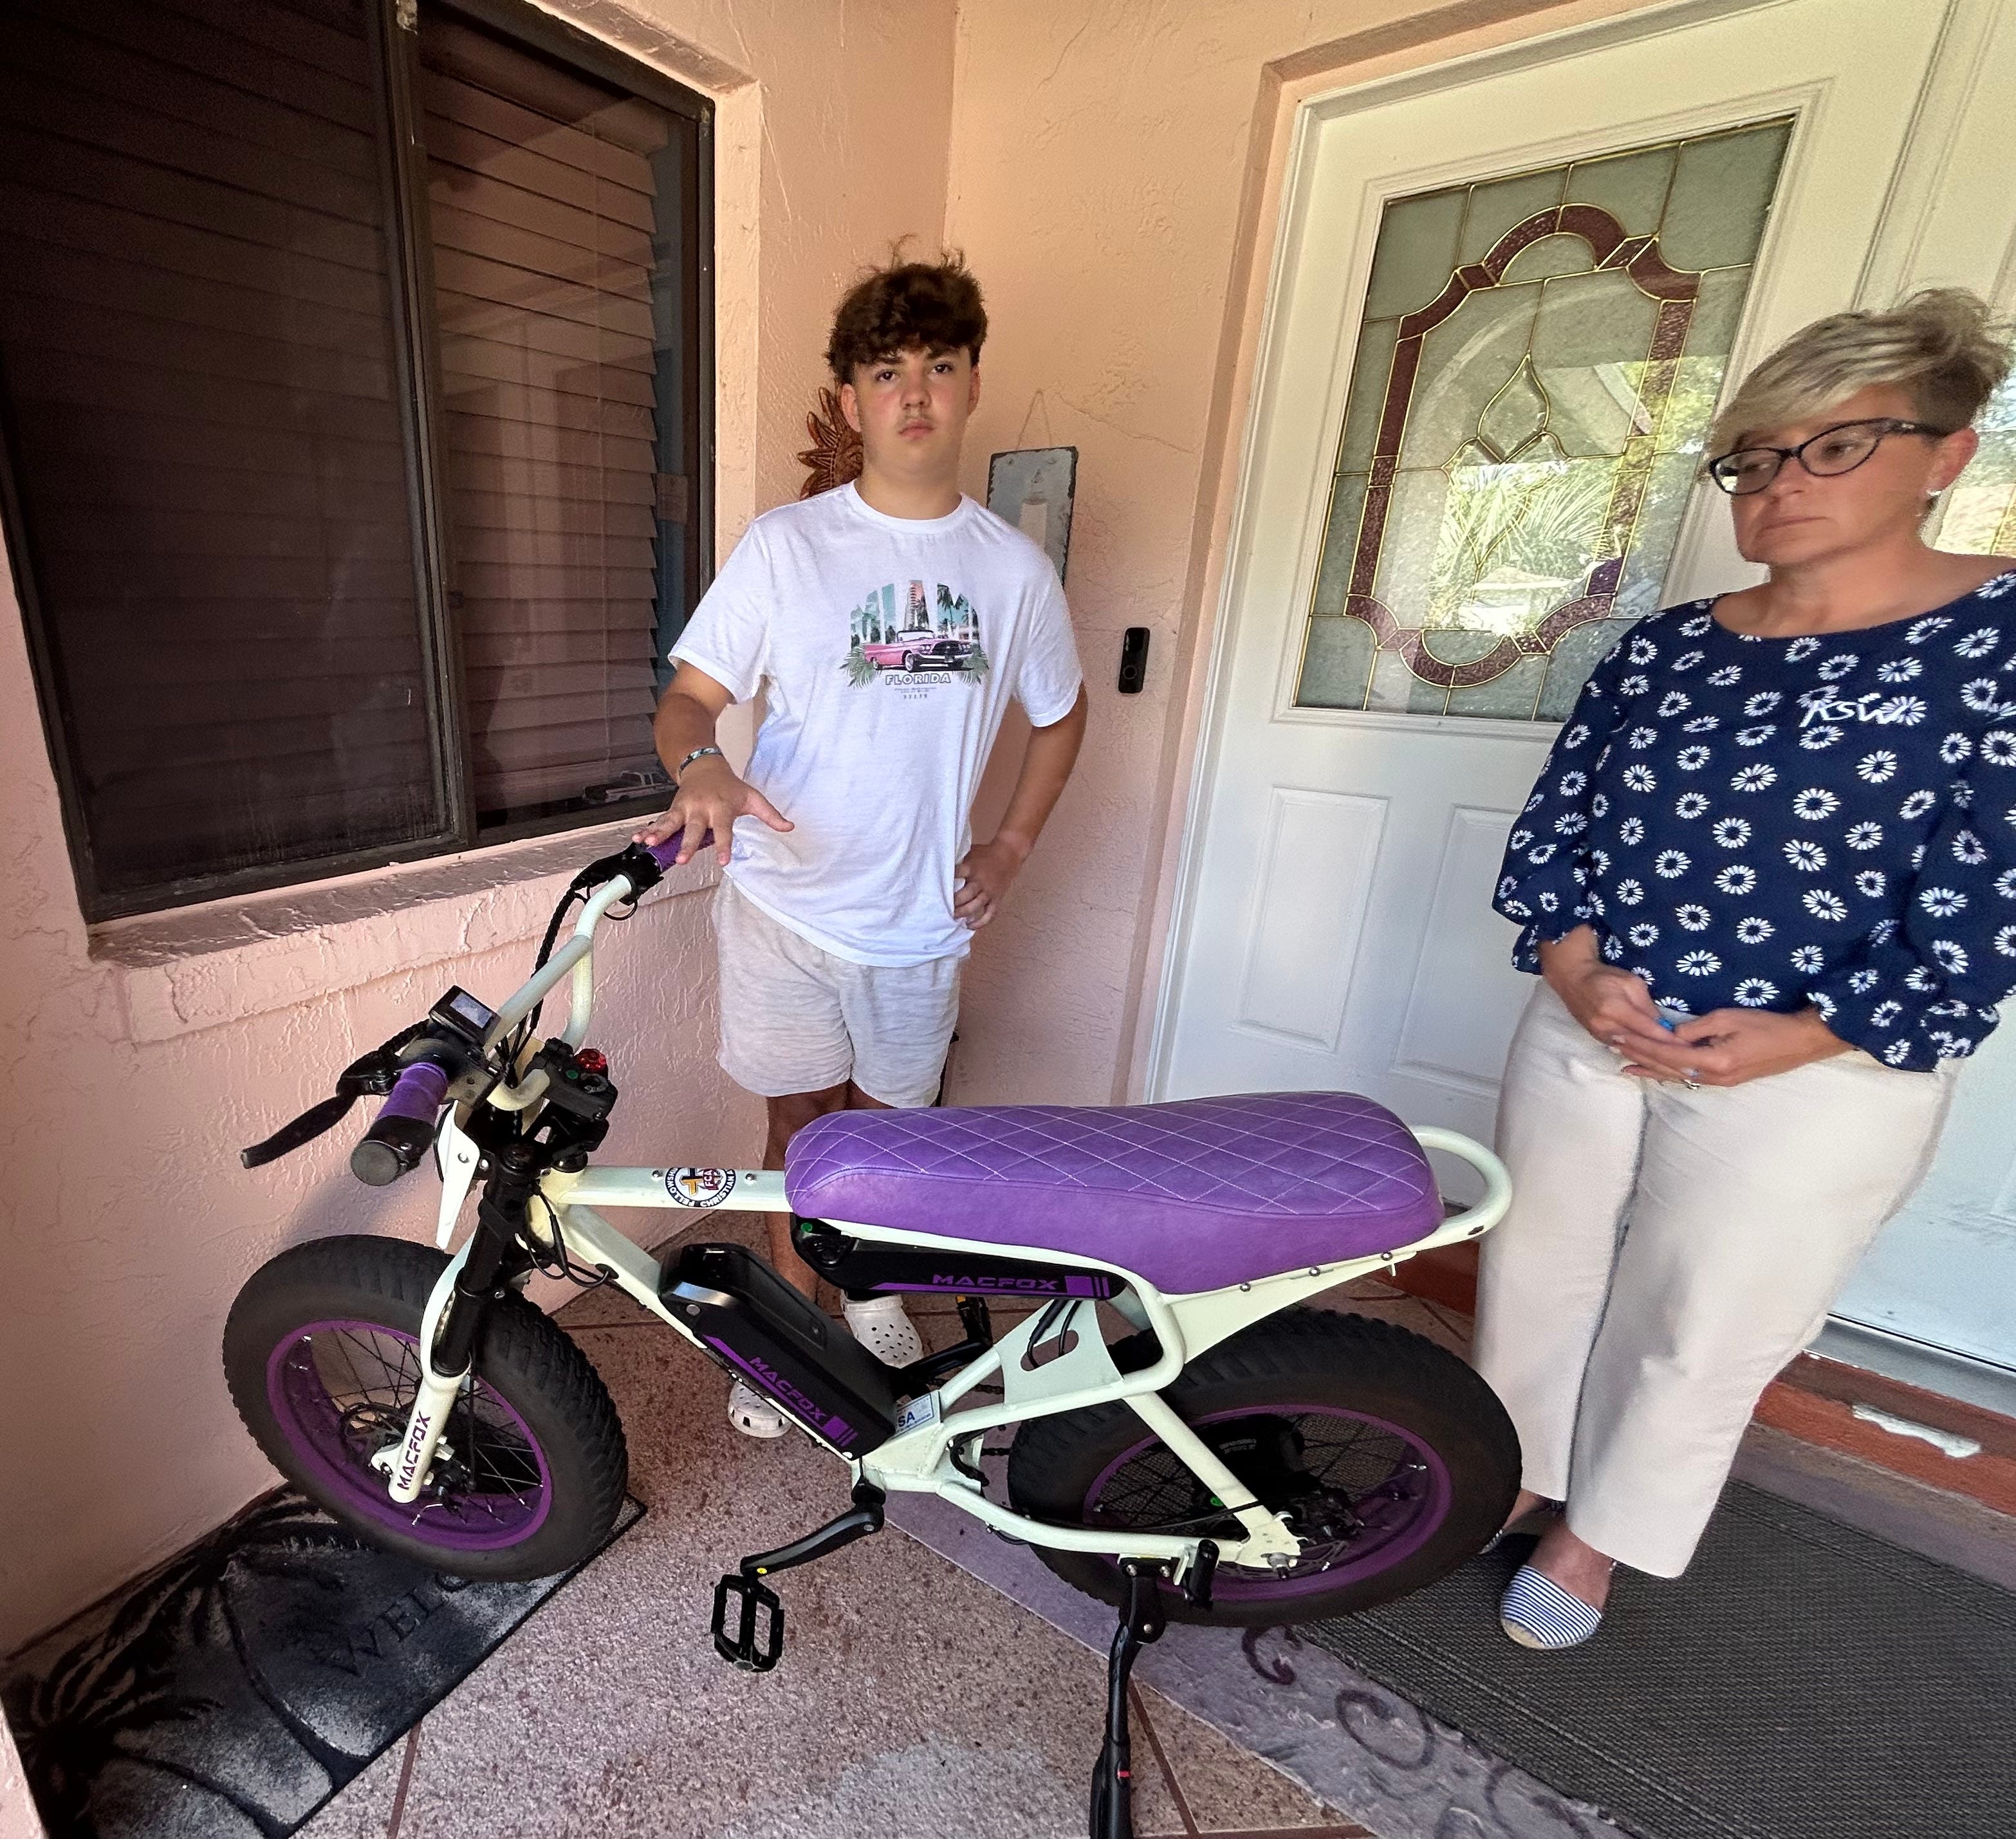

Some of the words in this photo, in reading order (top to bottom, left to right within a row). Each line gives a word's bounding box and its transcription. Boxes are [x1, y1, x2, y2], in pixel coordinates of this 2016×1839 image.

[885, 673, 951, 685] FLORIDA
[703, 1169, 714, 1187] FCA
[699, 1176, 734, 1207] CHRISTIAN
[933, 1274, 1058, 1290] MACFOX
[749, 1357, 826, 1420] MACFOX
[397, 1410, 431, 1490] MACFOX
